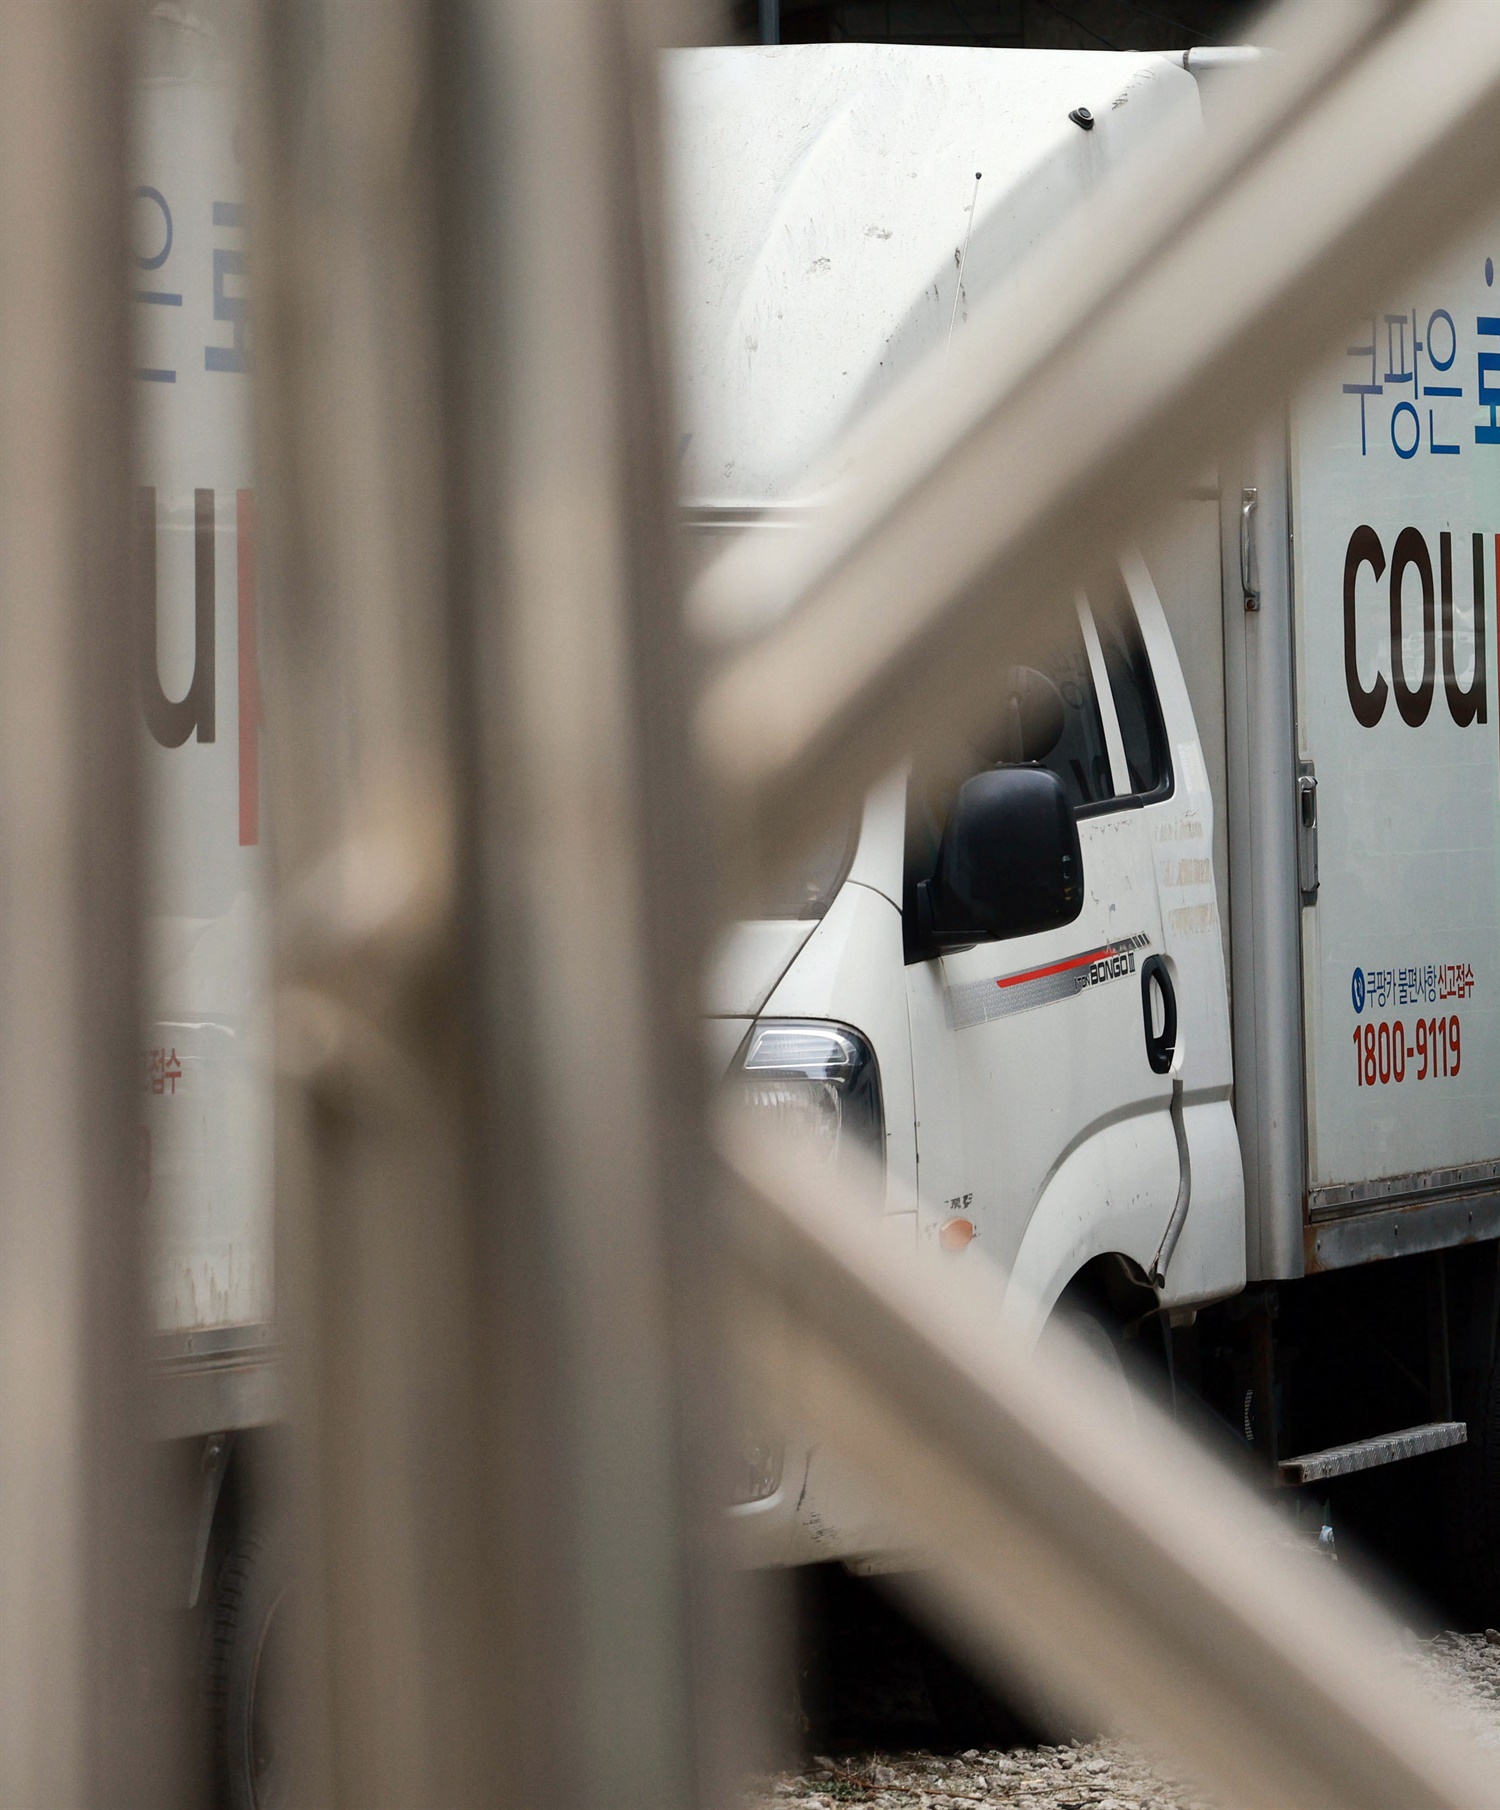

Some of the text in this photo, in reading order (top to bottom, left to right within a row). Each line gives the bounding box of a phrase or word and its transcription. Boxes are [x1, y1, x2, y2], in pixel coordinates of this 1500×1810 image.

[1366, 963, 1475, 1008] 쿠팡카 불편사항 신고접수
[1352, 1015, 1461, 1087] 1800-9119
